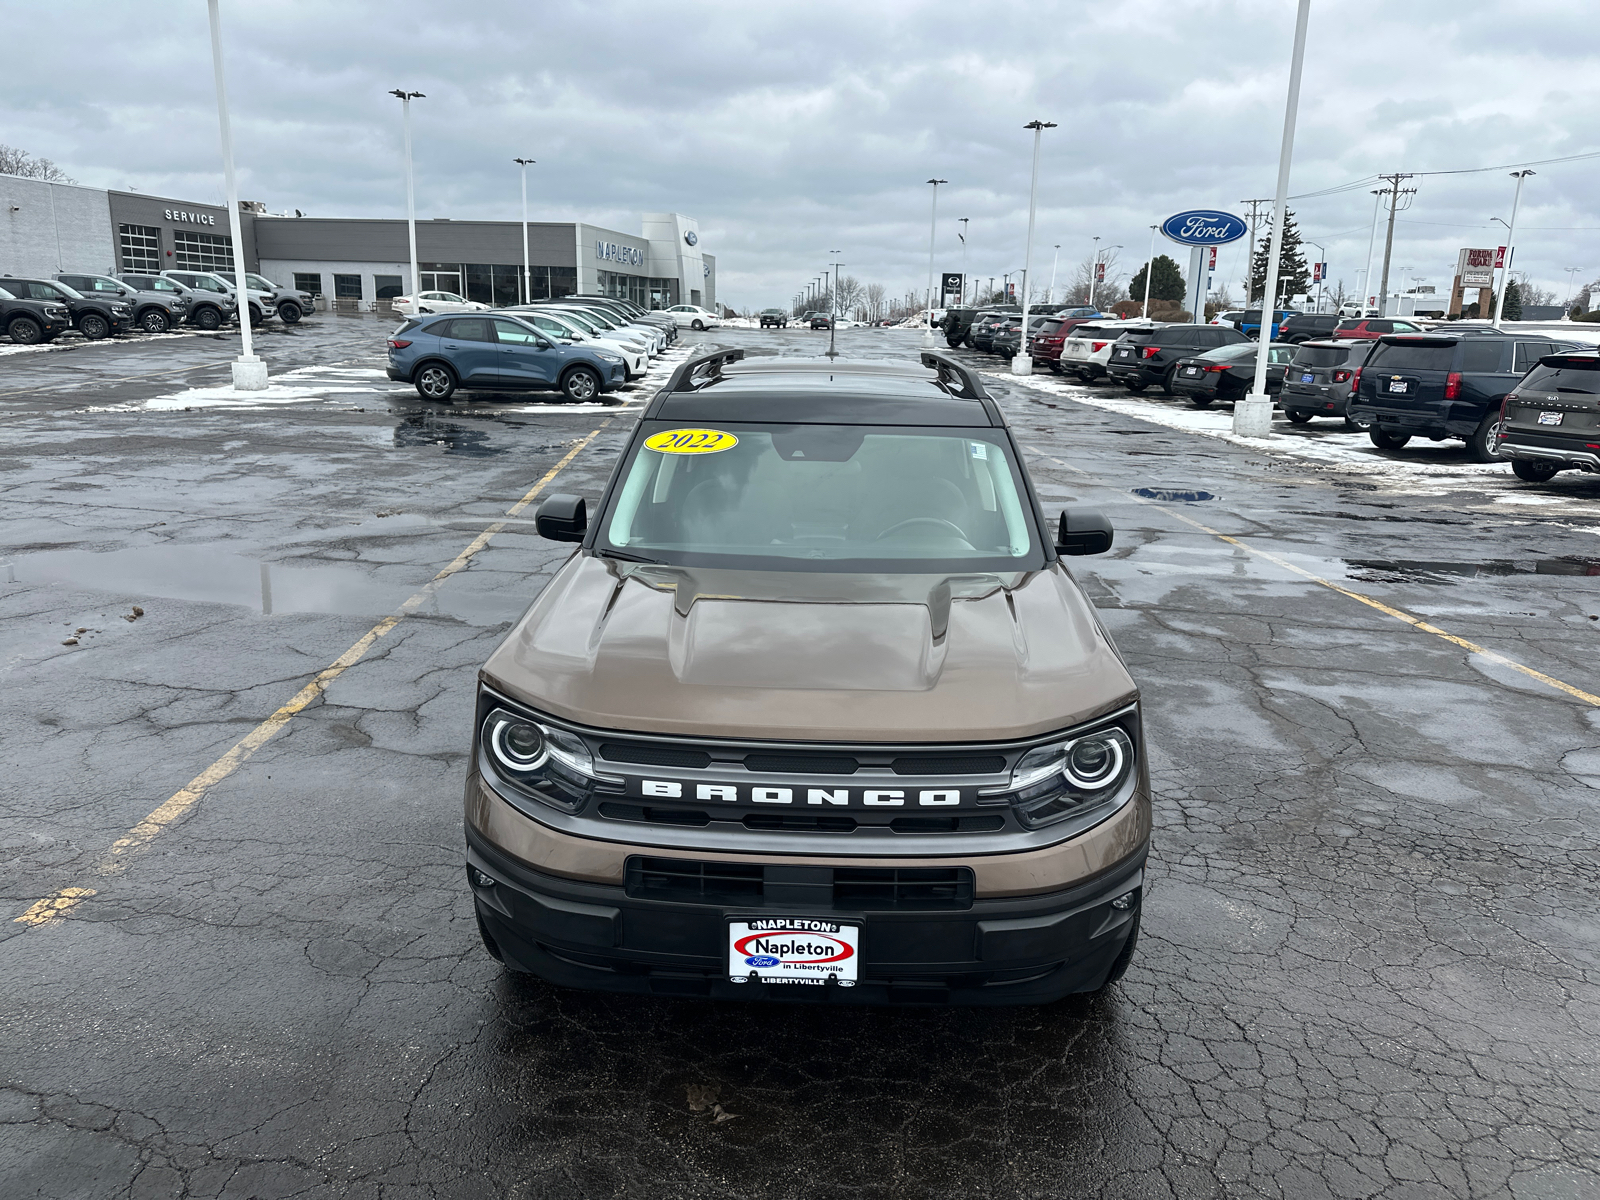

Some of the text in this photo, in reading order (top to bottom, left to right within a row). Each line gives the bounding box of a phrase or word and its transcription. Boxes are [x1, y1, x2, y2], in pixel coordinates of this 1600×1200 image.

[165, 209, 215, 226] SERVICE
[1180, 216, 1231, 239] Ford
[597, 240, 644, 266] NAPLETON
[1469, 249, 1493, 258] FORUM
[1467, 258, 1492, 267] SQUARE
[656, 433, 724, 448] 2022
[641, 780, 960, 806] BRONCO
[756, 919, 832, 932] NAPLETON
[755, 938, 835, 957] Napleton
[752, 957, 774, 966] Ford
[794, 963, 844, 972] Libertyville
[761, 977, 825, 986] LIBERTYVILLE
